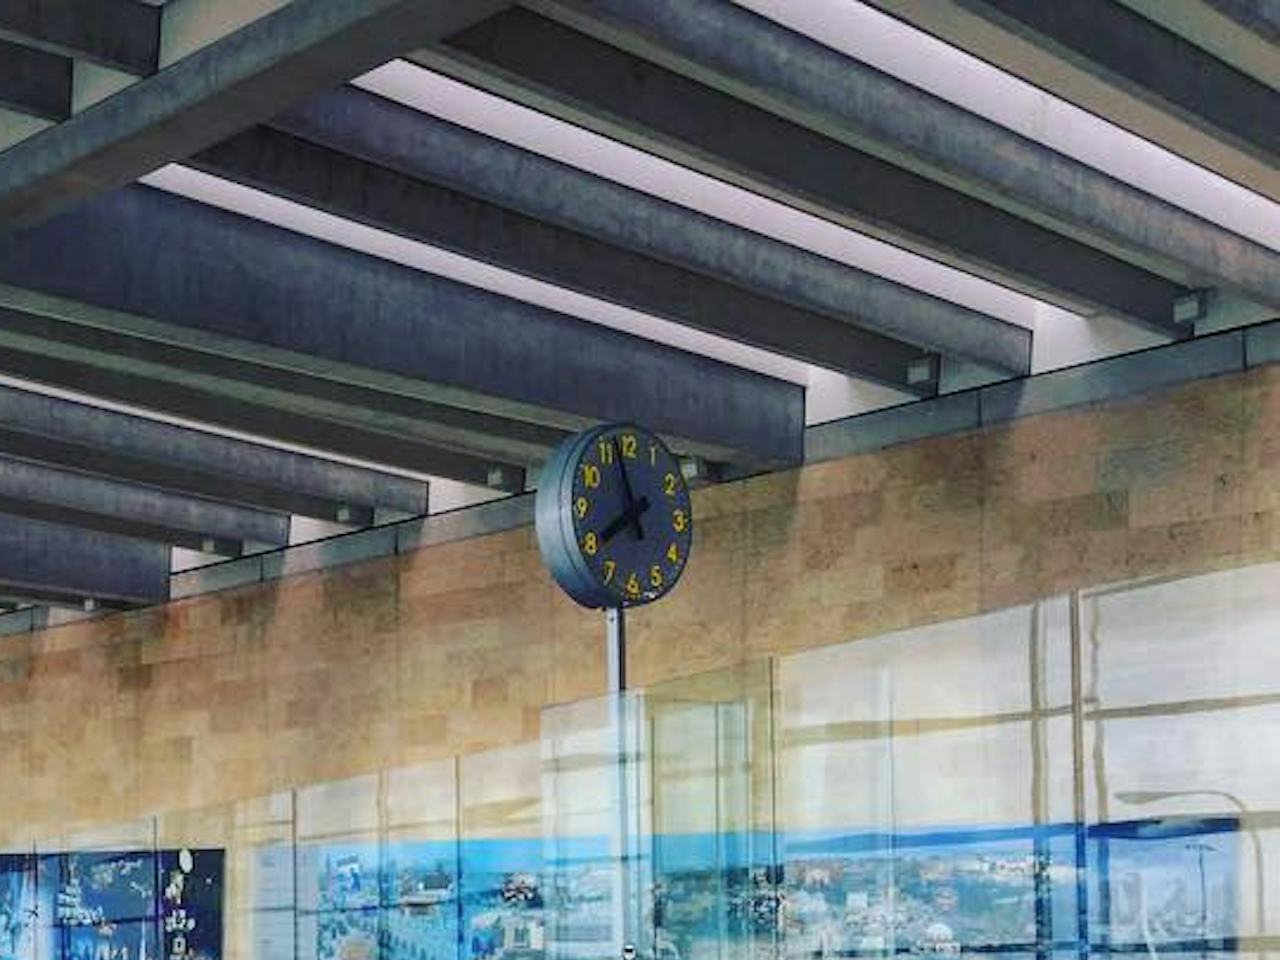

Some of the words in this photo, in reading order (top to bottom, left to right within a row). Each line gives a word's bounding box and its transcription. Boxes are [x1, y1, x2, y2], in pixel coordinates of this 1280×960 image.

[598, 439, 613, 465] 11
[621, 435, 637, 459] 12
[650, 446, 656, 467] 1
[582, 465, 600, 488] 10
[663, 473, 675, 495] 2
[576, 497, 588, 518] 9
[673, 510, 687, 533] 3
[584, 532, 597, 555] 8
[666, 544, 679, 564] 4
[602, 561, 615, 585] 7
[650, 565, 663, 587] 5
[626, 573, 641, 597] 6
